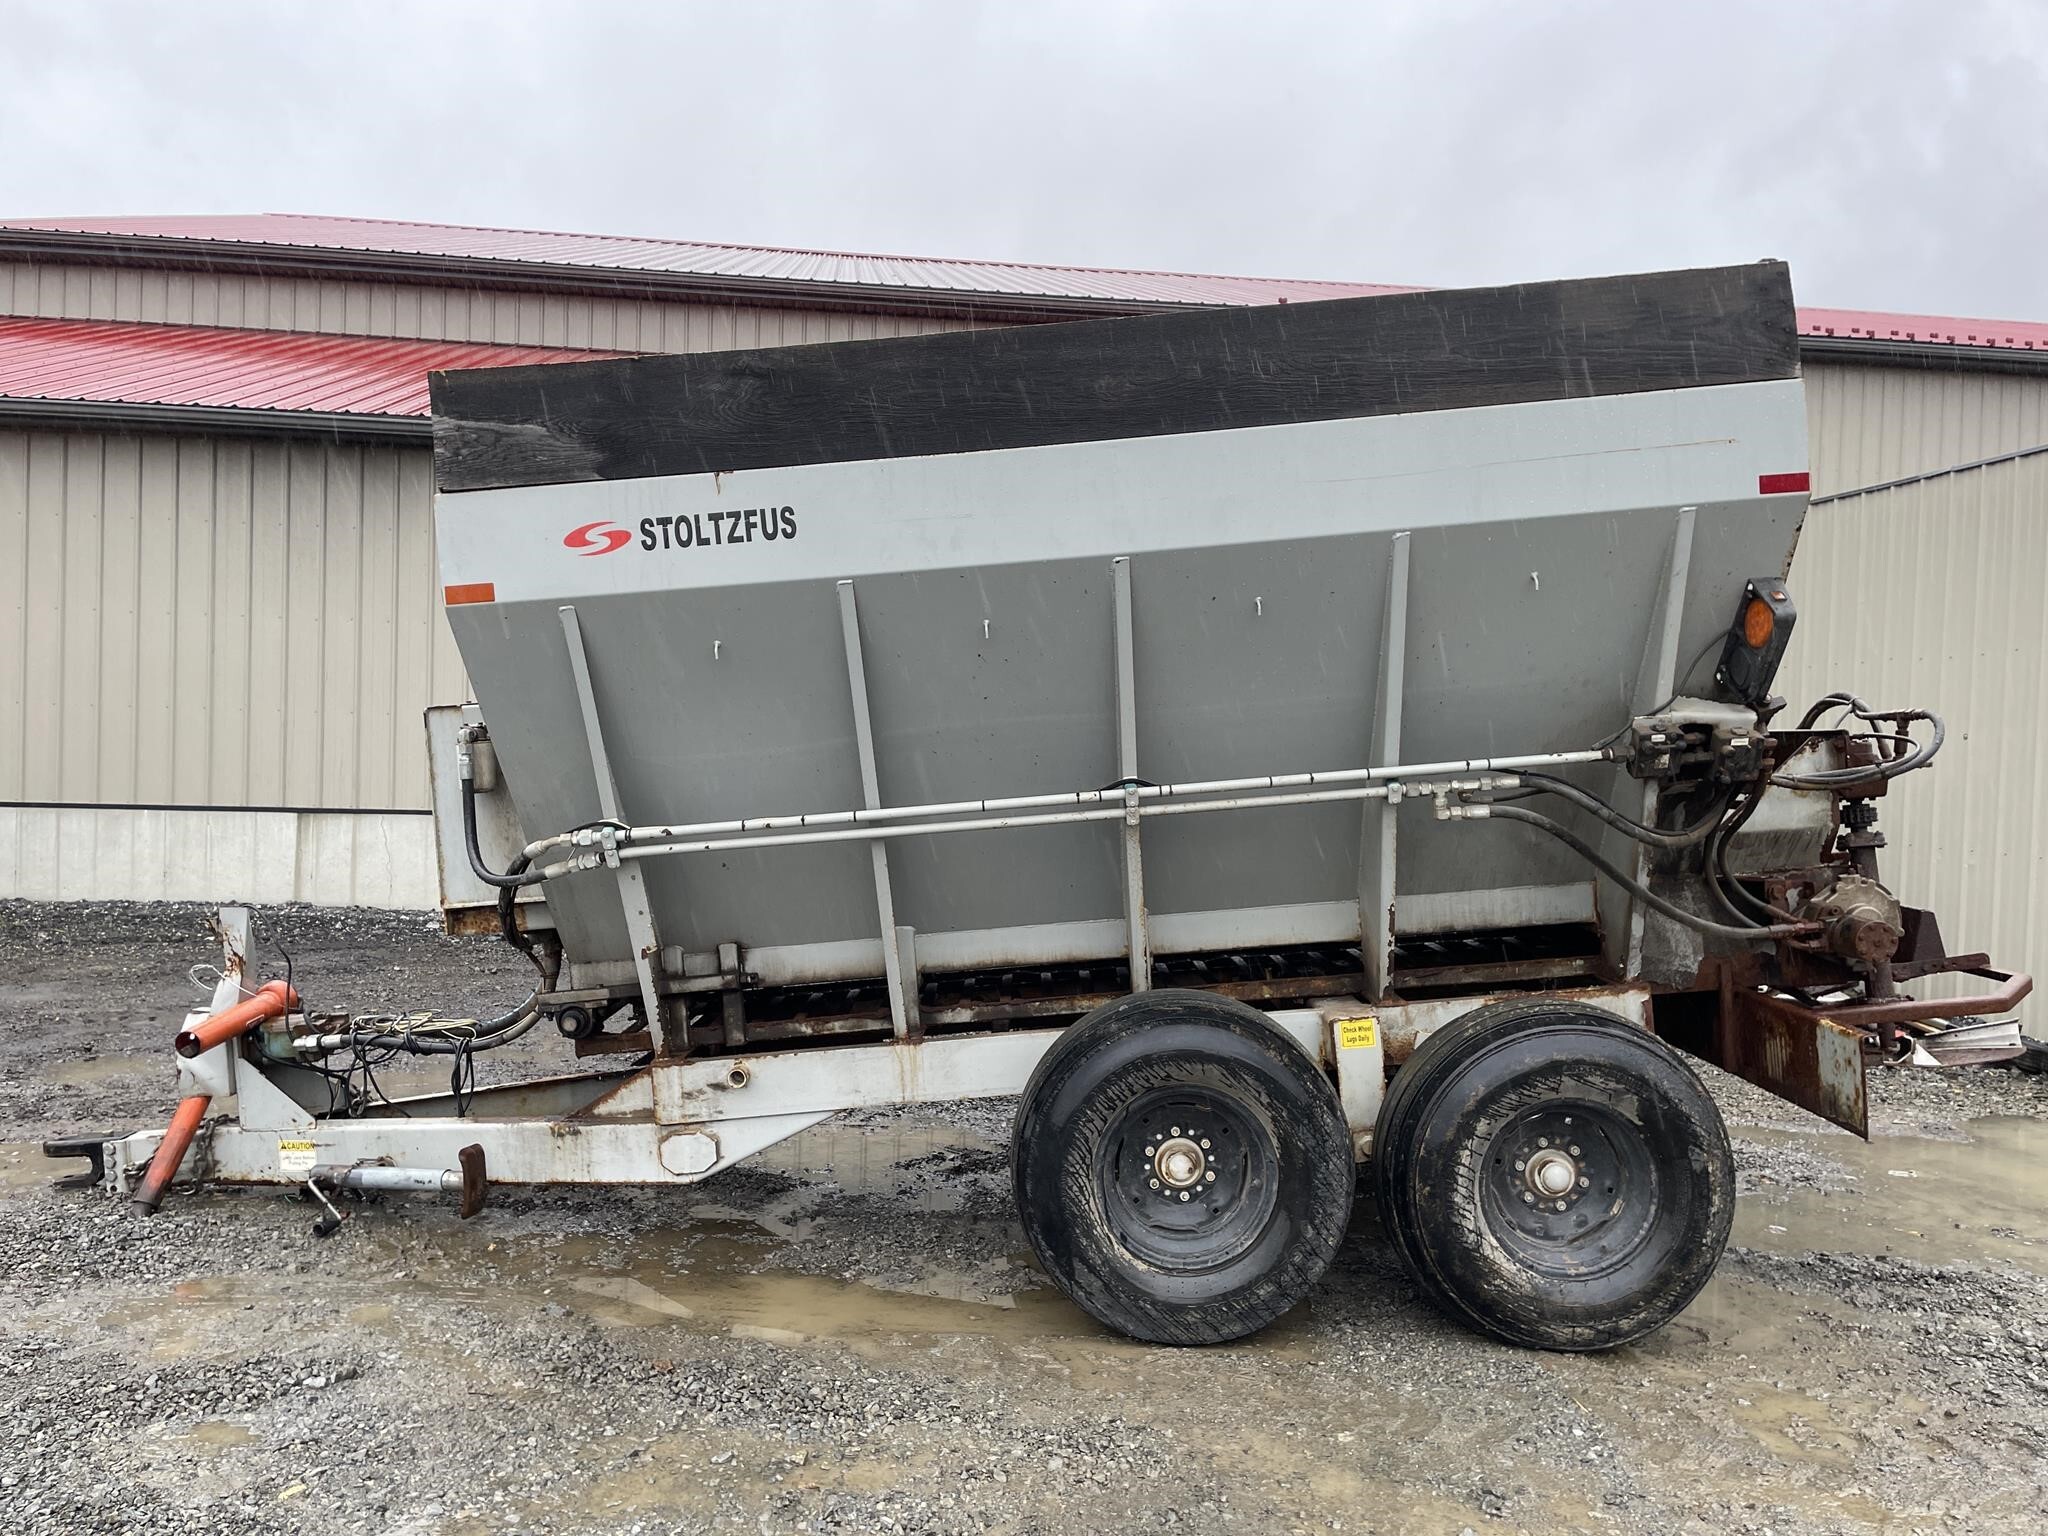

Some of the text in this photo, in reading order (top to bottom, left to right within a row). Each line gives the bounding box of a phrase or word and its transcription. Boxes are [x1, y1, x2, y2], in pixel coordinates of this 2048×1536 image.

[639, 505, 797, 551] STOLTZFUS
[1358, 1034, 1370, 1042] Daily
[287, 1142, 315, 1150] CAUTION
